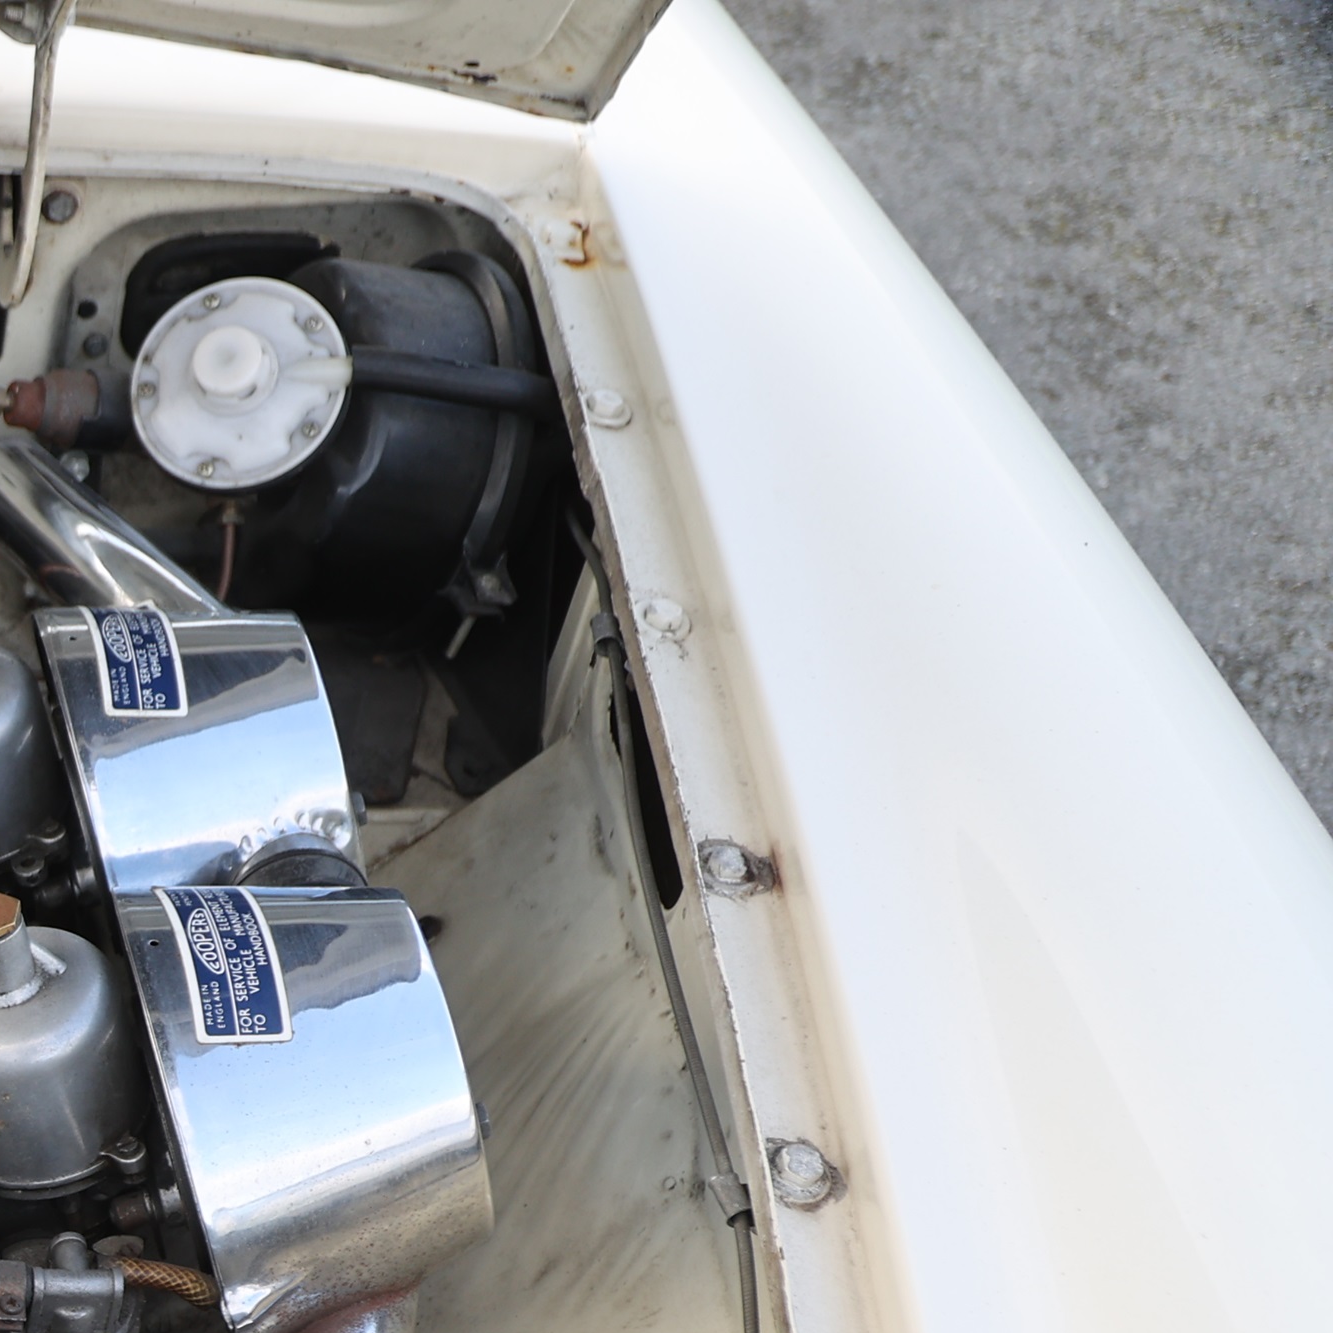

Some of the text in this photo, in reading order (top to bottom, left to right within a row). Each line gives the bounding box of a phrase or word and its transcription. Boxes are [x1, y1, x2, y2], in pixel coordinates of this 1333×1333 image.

[105, 615, 129, 659] COOPERS
[132, 634, 144, 646] OF
[119, 665, 131, 705] ENGLAND
[136, 649, 152, 684] SERVICE
[147, 643, 166, 709] TO VEHICLE
[143, 688, 154, 709] FOR
[192, 912, 220, 969] COOPERS
[209, 901, 253, 1033] FOR SERVICE OF ELEMENT
[240, 949, 261, 994] VEHICLE
[201, 984, 214, 1026] MADE IN
[210, 980, 226, 1029] ENGLAND
[254, 1014, 267, 1033] TO
